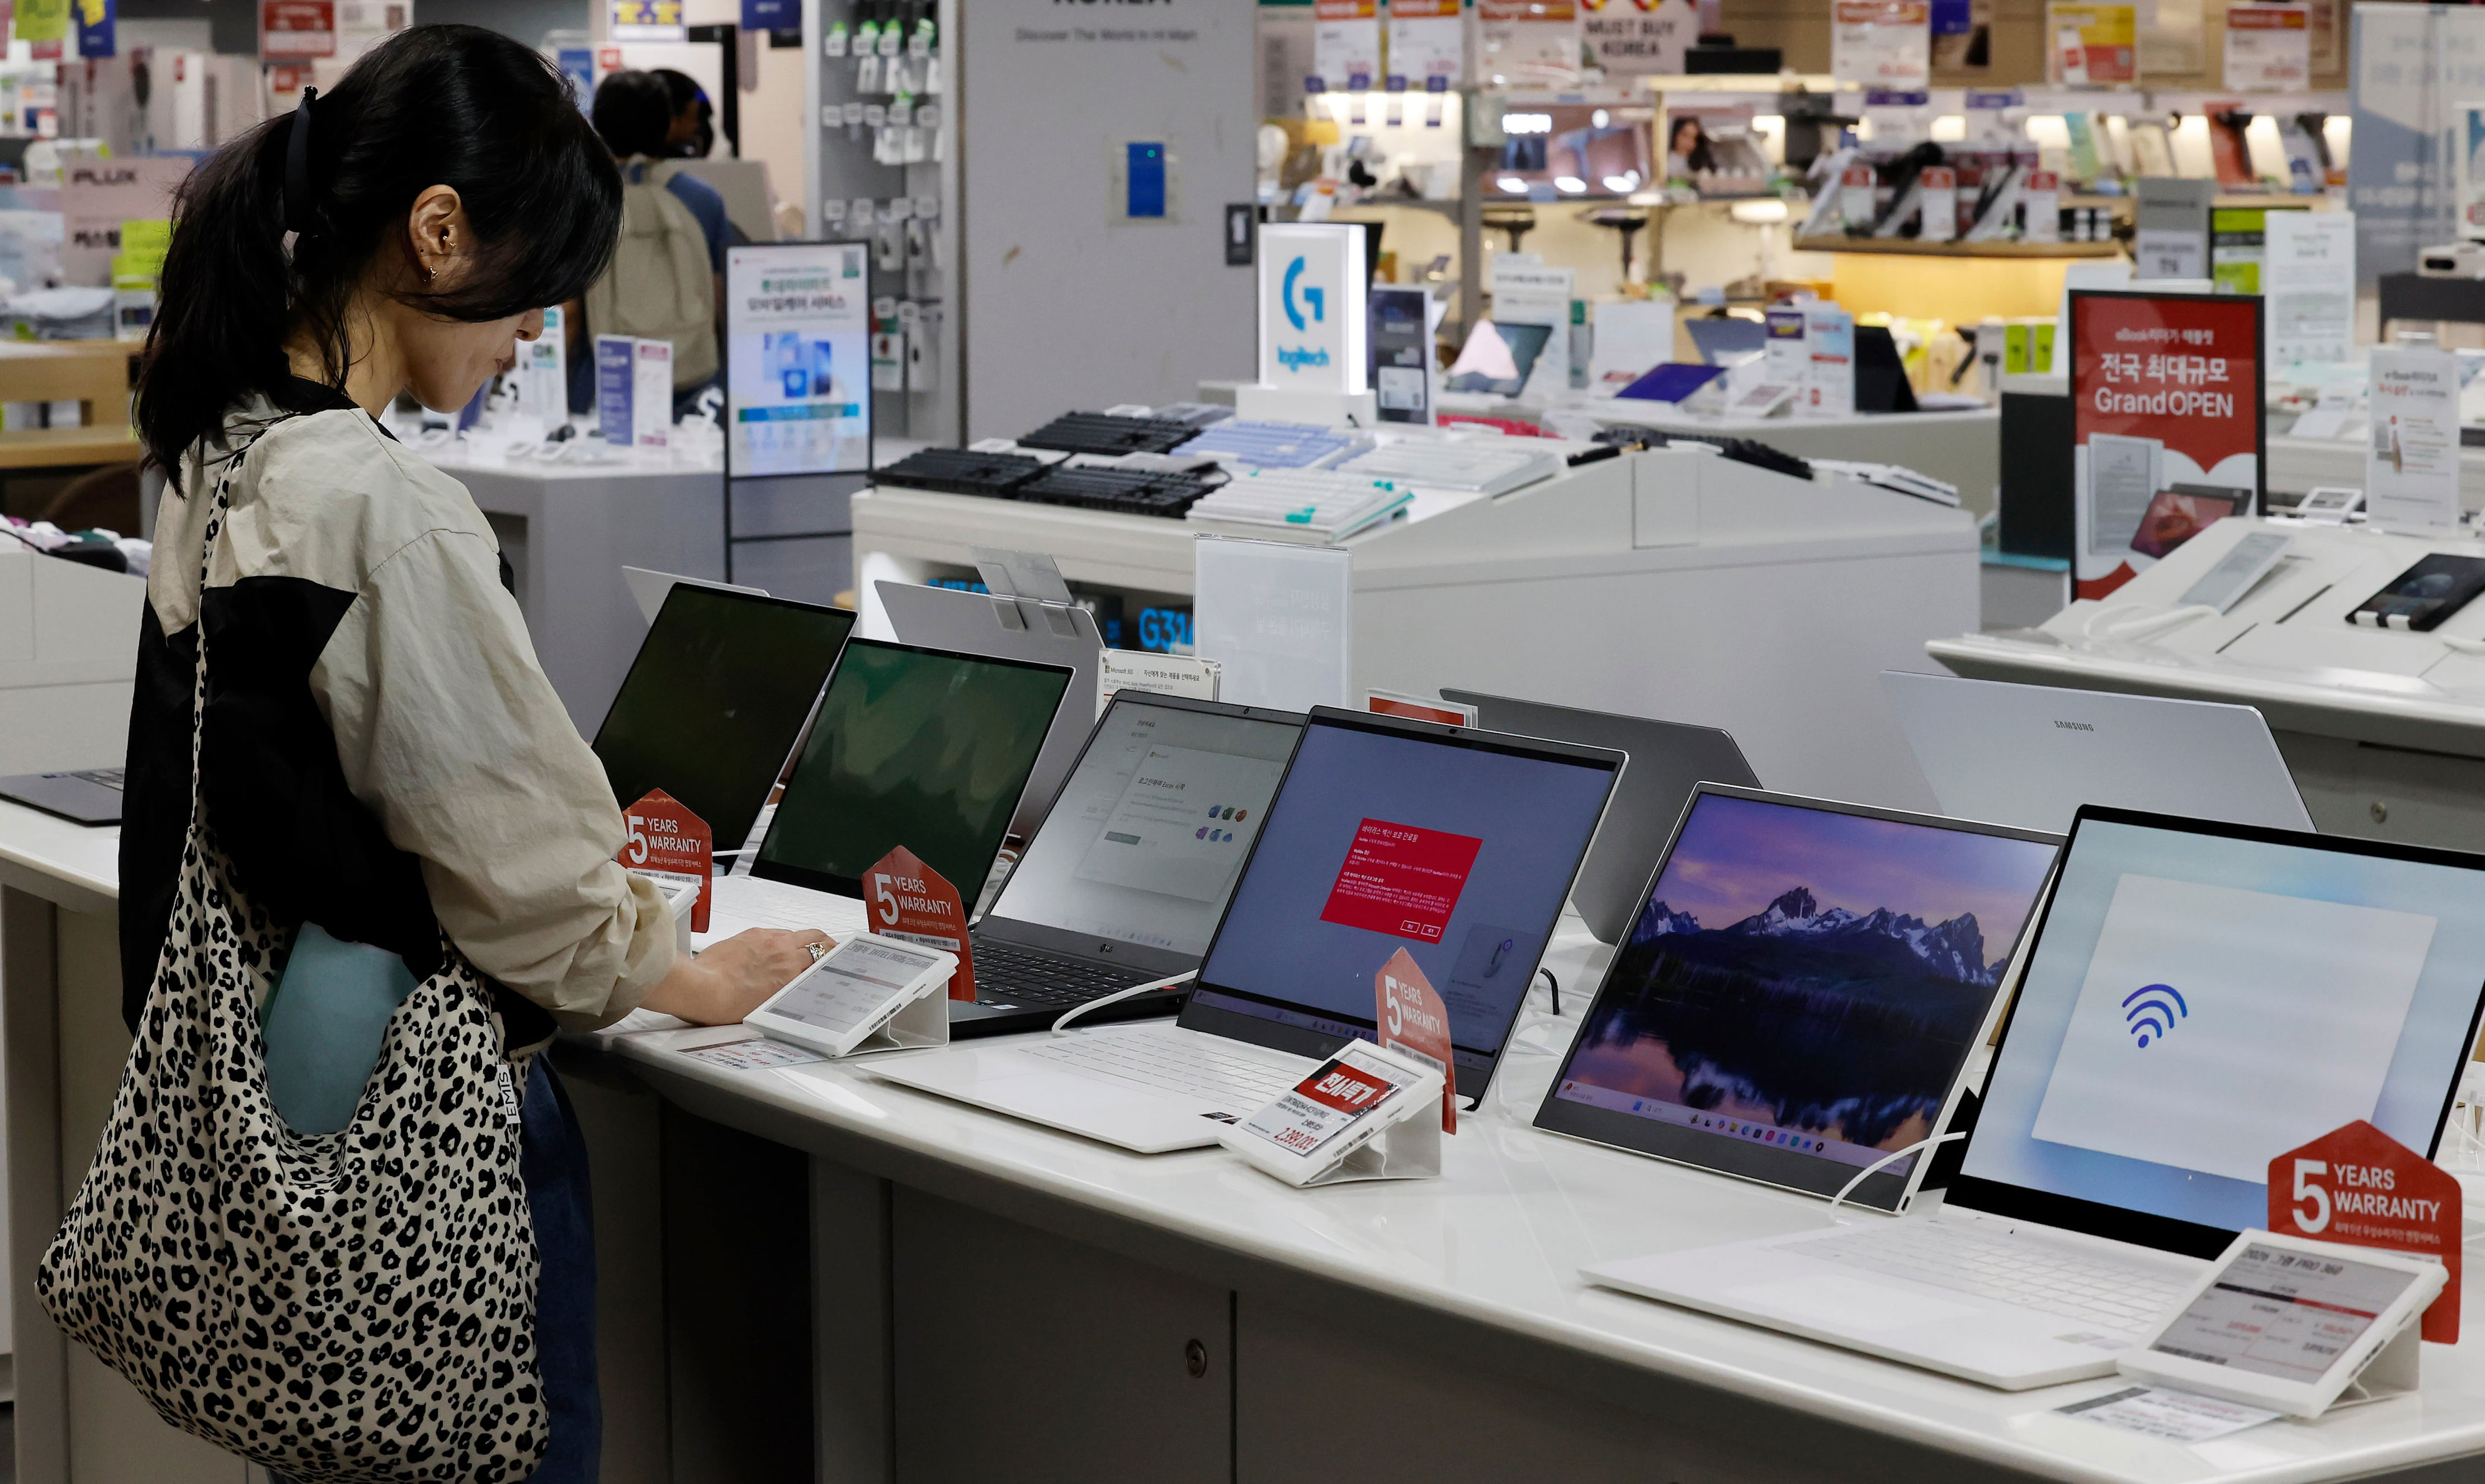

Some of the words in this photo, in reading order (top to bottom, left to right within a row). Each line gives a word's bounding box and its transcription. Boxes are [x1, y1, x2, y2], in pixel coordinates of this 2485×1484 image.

[1277, 344, 1330, 372] logitech
[2100, 352, 2142, 384] 전국
[2146, 354, 2230, 386] 최대규모
[1139, 607, 1193, 651] G31
[1181, 673, 1200, 682] 선택하세요
[2054, 720, 2094, 731] SAMSUNG
[627, 815, 648, 864] 5
[647, 817, 678, 834] YEARS
[648, 835, 701, 853] WARRANTY
[1362, 826, 1381, 835] 바이러스
[1382, 829, 1392, 838] 백신
[1392, 830, 1403, 839] 보호
[1402, 833, 1419, 843] 만료됨
[874, 873, 899, 925] 5
[893, 876, 927, 895] YEARS
[897, 895, 952, 916] WARRANTY
[1385, 975, 1402, 1037] 5
[1398, 981, 1422, 1006] YEARS
[1401, 1004, 1440, 1034] WARRANTY
[499, 1072, 517, 1117] EMIS
[1314, 1072, 1378, 1105] 전시특가
[1274, 1126, 1320, 1151] 2,399,000
[2292, 1158, 2331, 1234] 5
[2333, 1163, 2396, 1190] YEARS
[2333, 1190, 2441, 1222] WARRANTY
